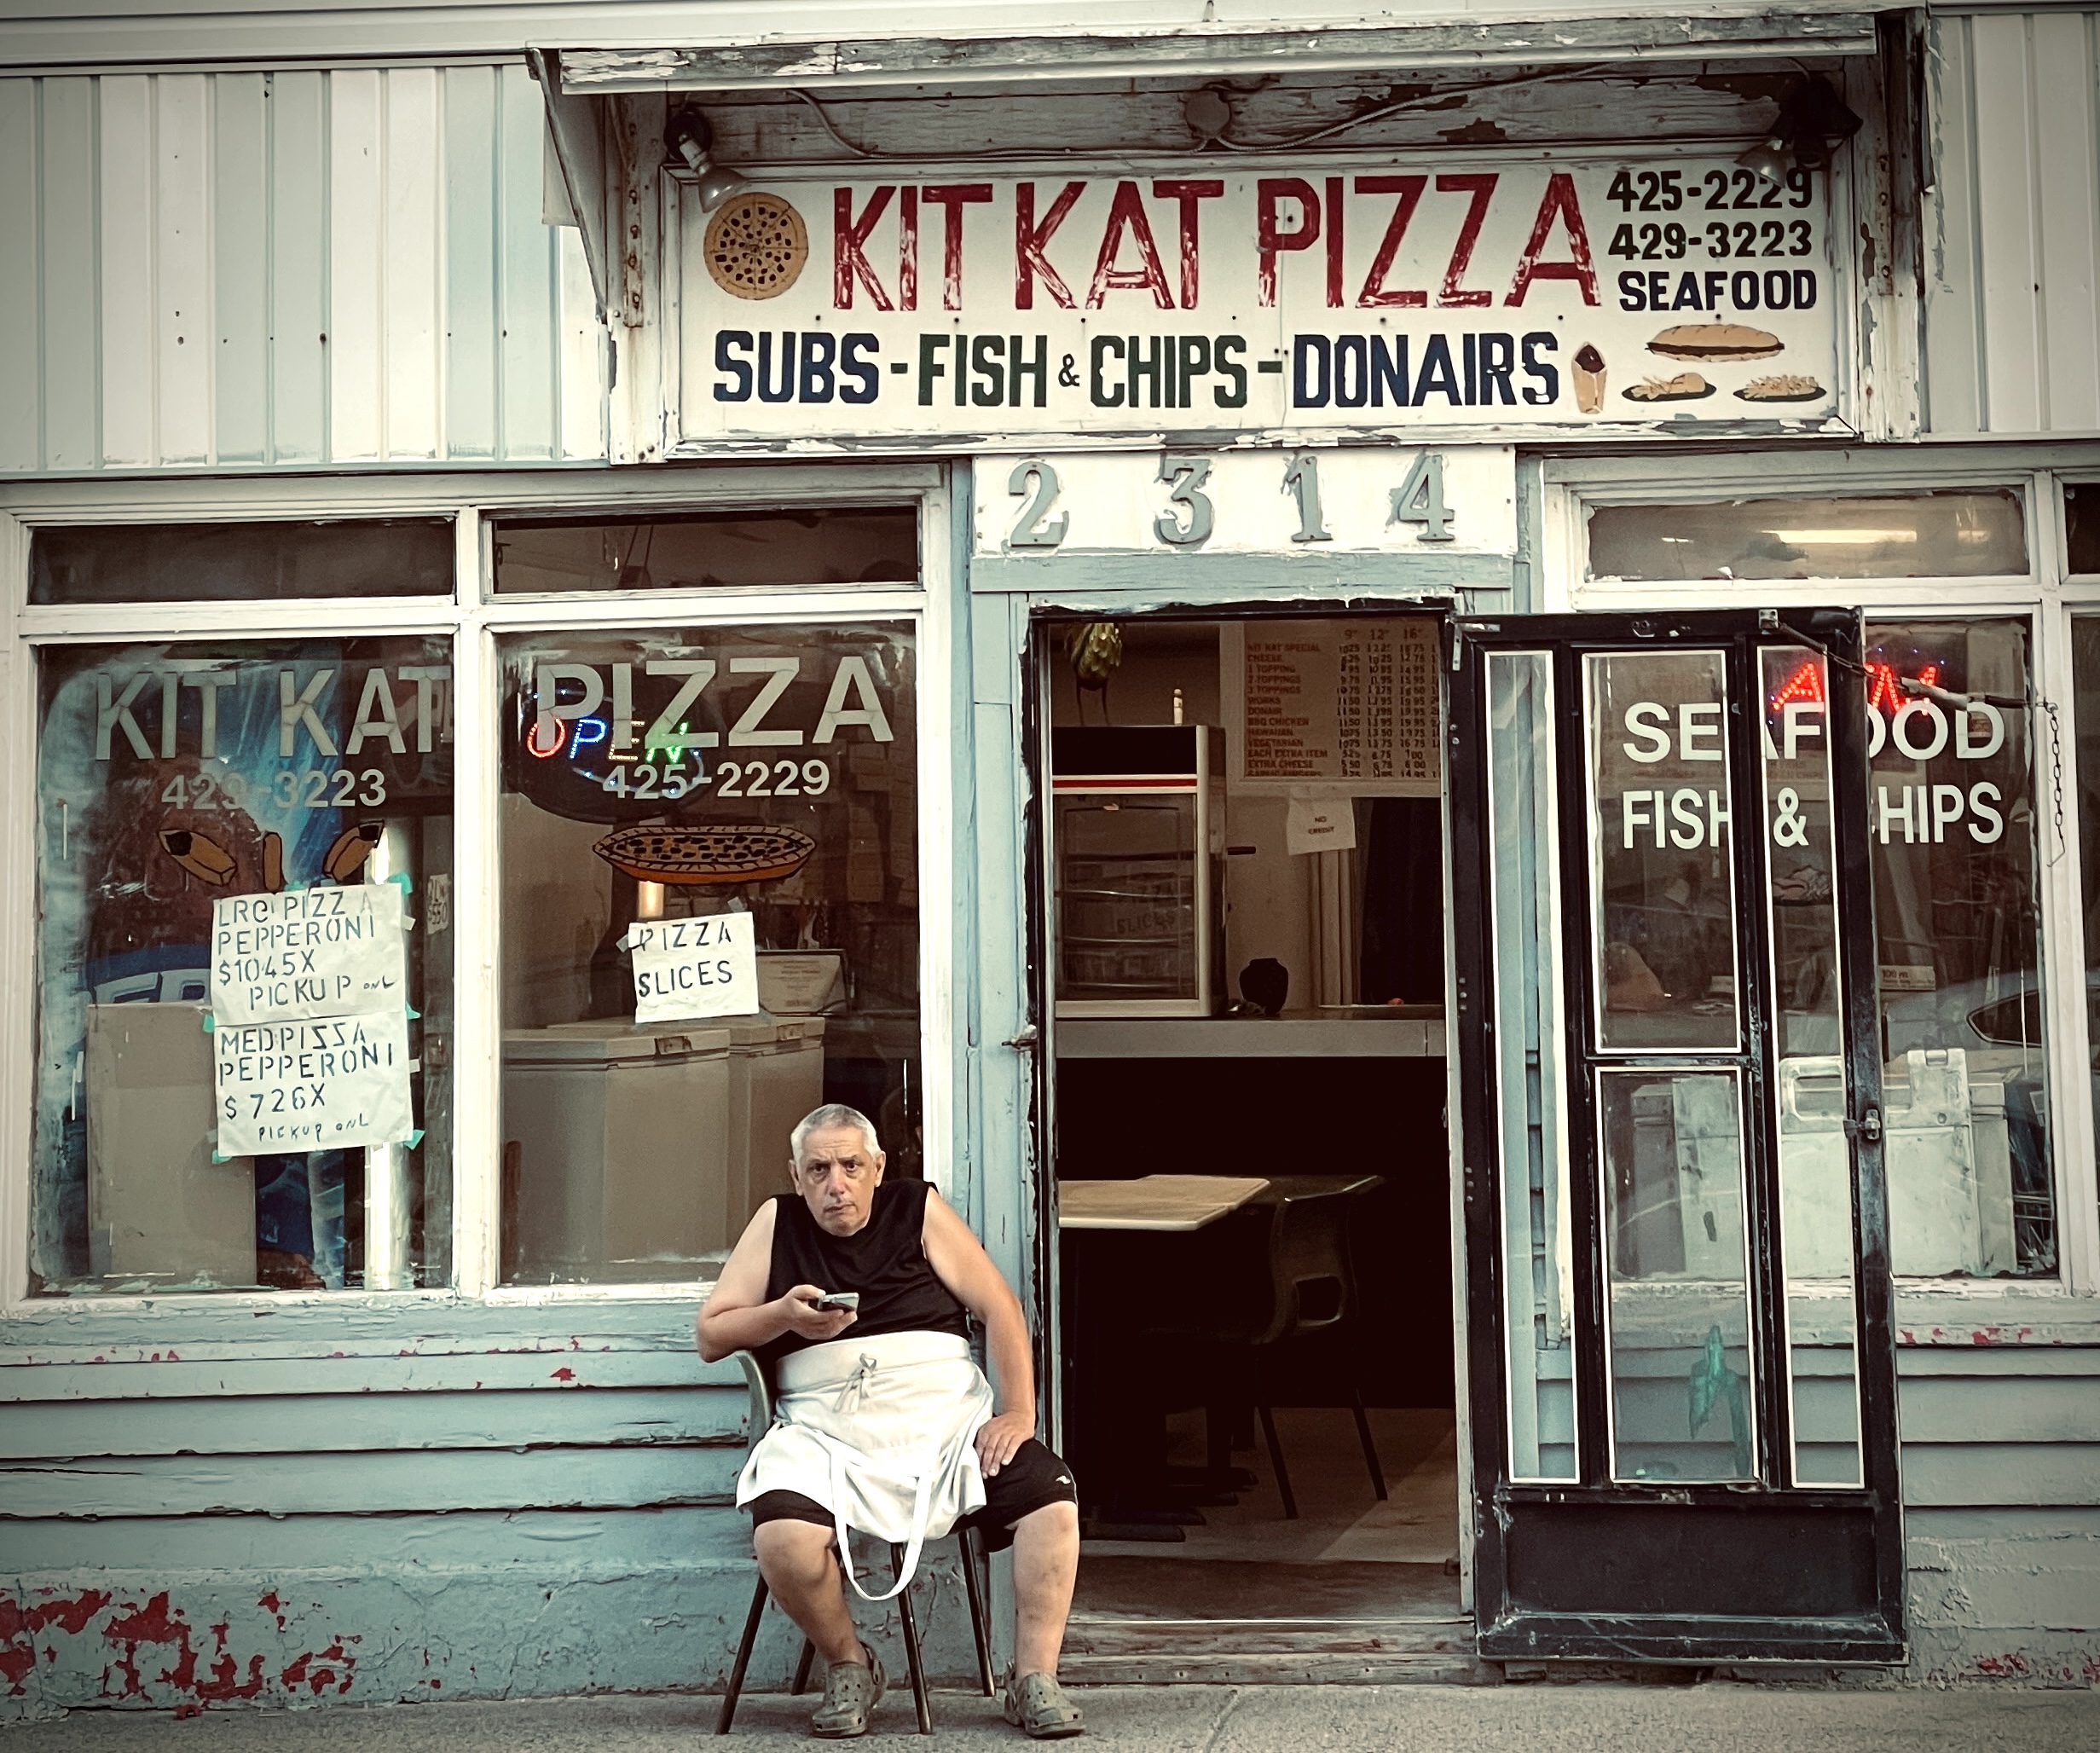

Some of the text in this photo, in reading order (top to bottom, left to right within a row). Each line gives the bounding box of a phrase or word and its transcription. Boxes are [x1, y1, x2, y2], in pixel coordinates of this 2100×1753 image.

[1606, 169, 1813, 212] 425-2229
[833, 172, 1603, 311] KIT KAT PIZZA
[1607, 220, 1812, 260] 429-3223
[1618, 269, 1817, 311] SEAFOOD
[1058, 353, 1079, 387] &
[535, 656, 894, 751] PIZZA
[1773, 662, 1937, 713] AM
[95, 666, 451, 761] KIT KAT
[161, 768, 387, 811] 429-3223
[602, 759, 830, 800] 425-2229
[1773, 787, 1809, 848] &
[1878, 782, 2004, 845] HIPS
[284, 890, 373, 921] PIZZA
[218, 915, 374, 955] PEPPERONI
[638, 921, 732, 952] PIZZA
[250, 975, 351, 1011] PICKUP
[638, 960, 732, 998] SLICES
[220, 1043, 392, 1086] PEPPERONI
[258, 1123, 322, 1143] PICKUP
